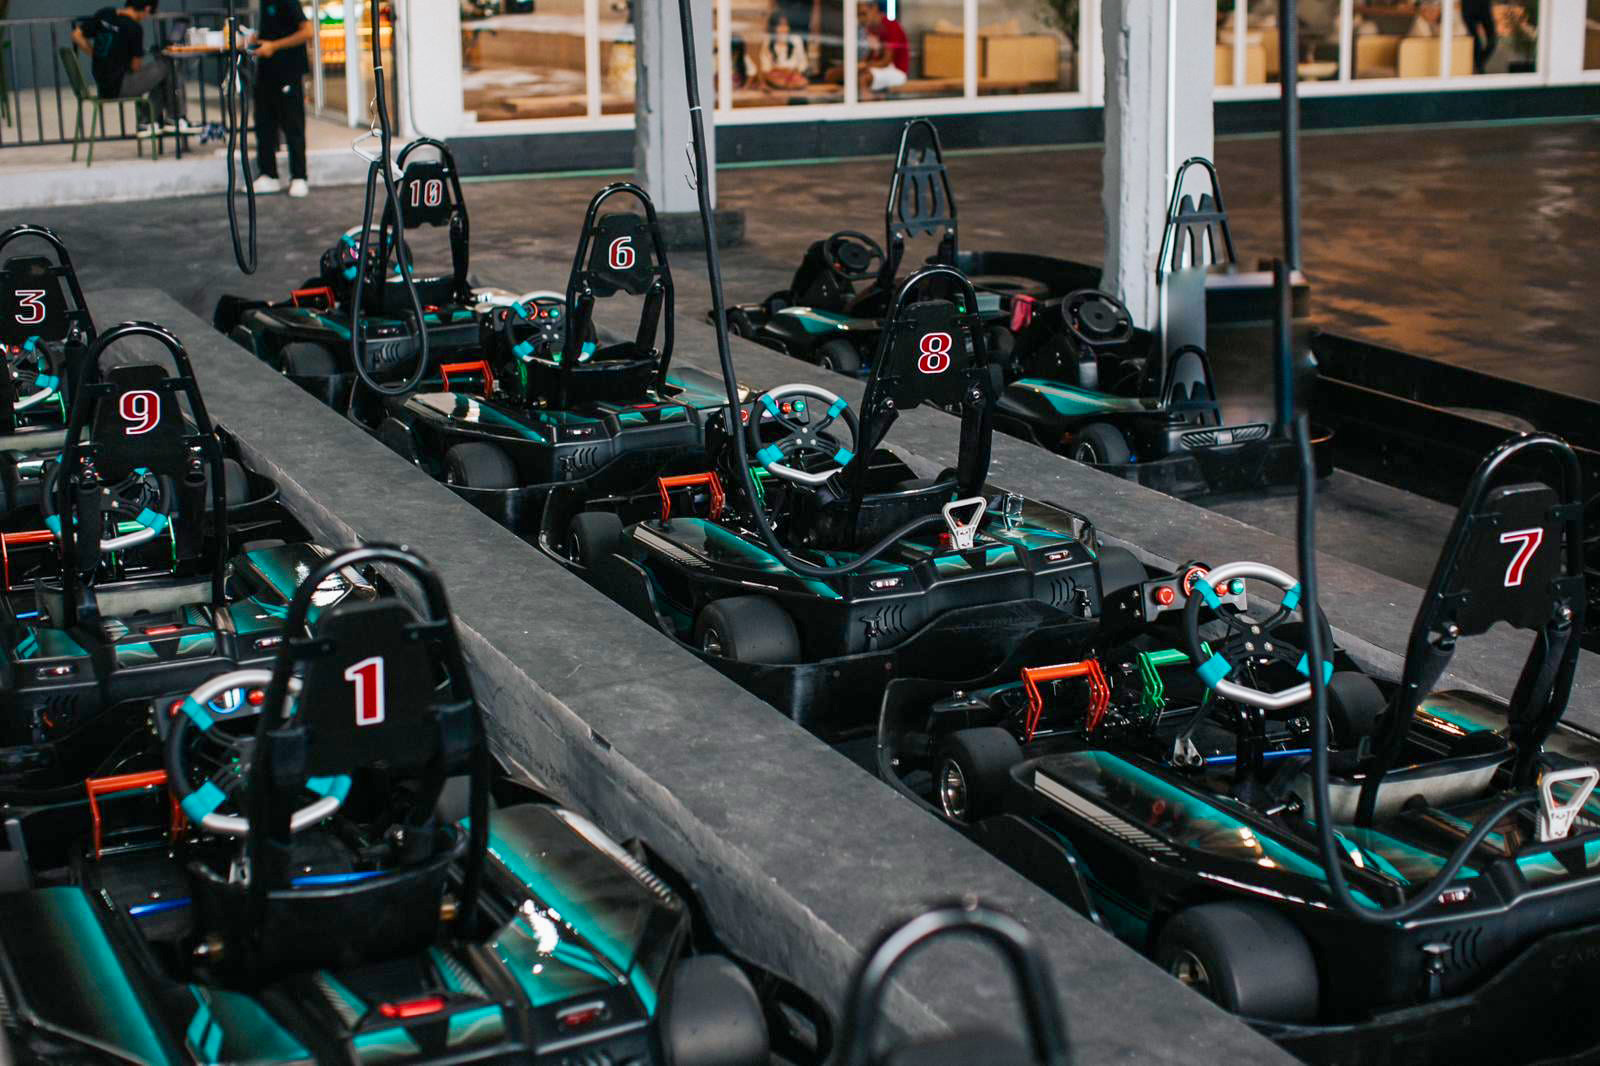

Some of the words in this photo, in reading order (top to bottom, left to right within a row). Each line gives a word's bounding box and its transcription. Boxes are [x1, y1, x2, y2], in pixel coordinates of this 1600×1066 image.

[410, 179, 442, 206] 10
[609, 236, 635, 270] 6
[15, 290, 46, 325] 3
[917, 332, 952, 375] 8
[119, 390, 160, 435] 9
[1500, 528, 1545, 587] 7
[345, 656, 385, 727] 1
